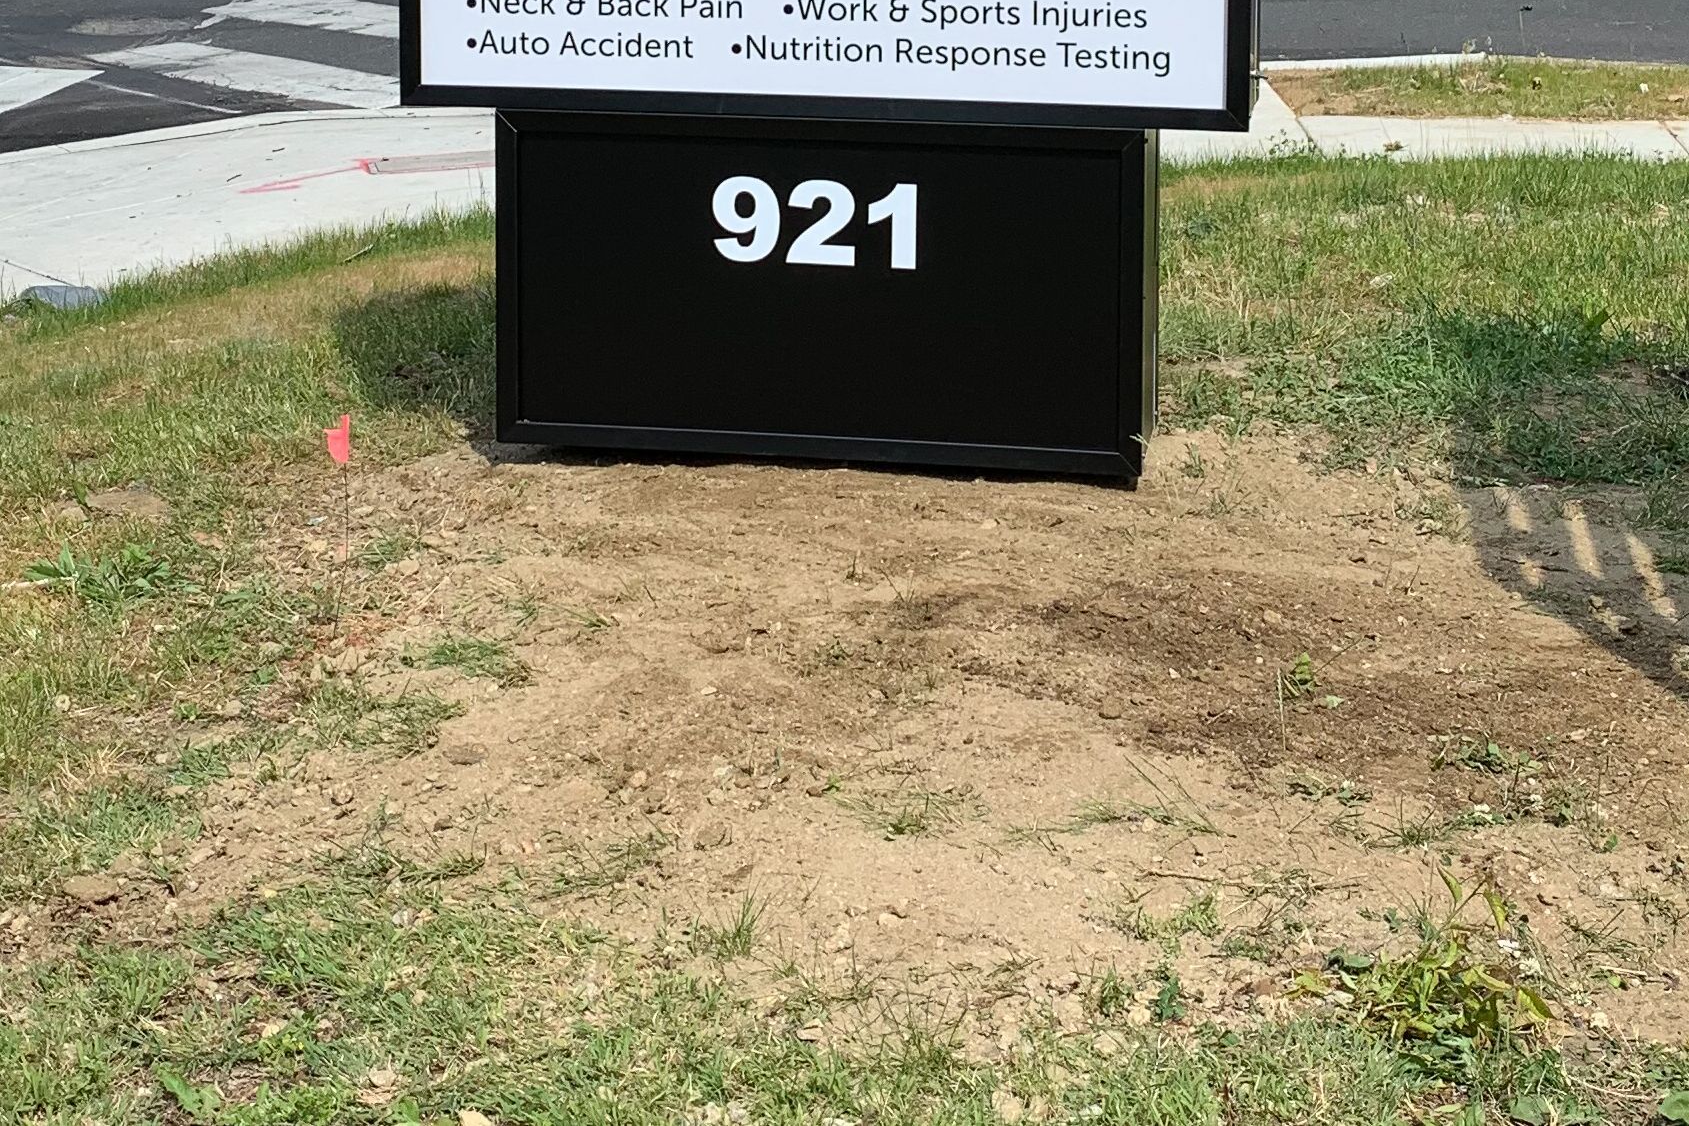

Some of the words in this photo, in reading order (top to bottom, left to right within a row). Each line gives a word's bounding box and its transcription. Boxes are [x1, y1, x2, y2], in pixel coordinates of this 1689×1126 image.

[1033, 0, 1148, 34] Injuries
[559, 31, 694, 59] Accident
[895, 38, 1047, 72] Response
[1055, 42, 1170, 78] Testing
[712, 175, 918, 270] 921
